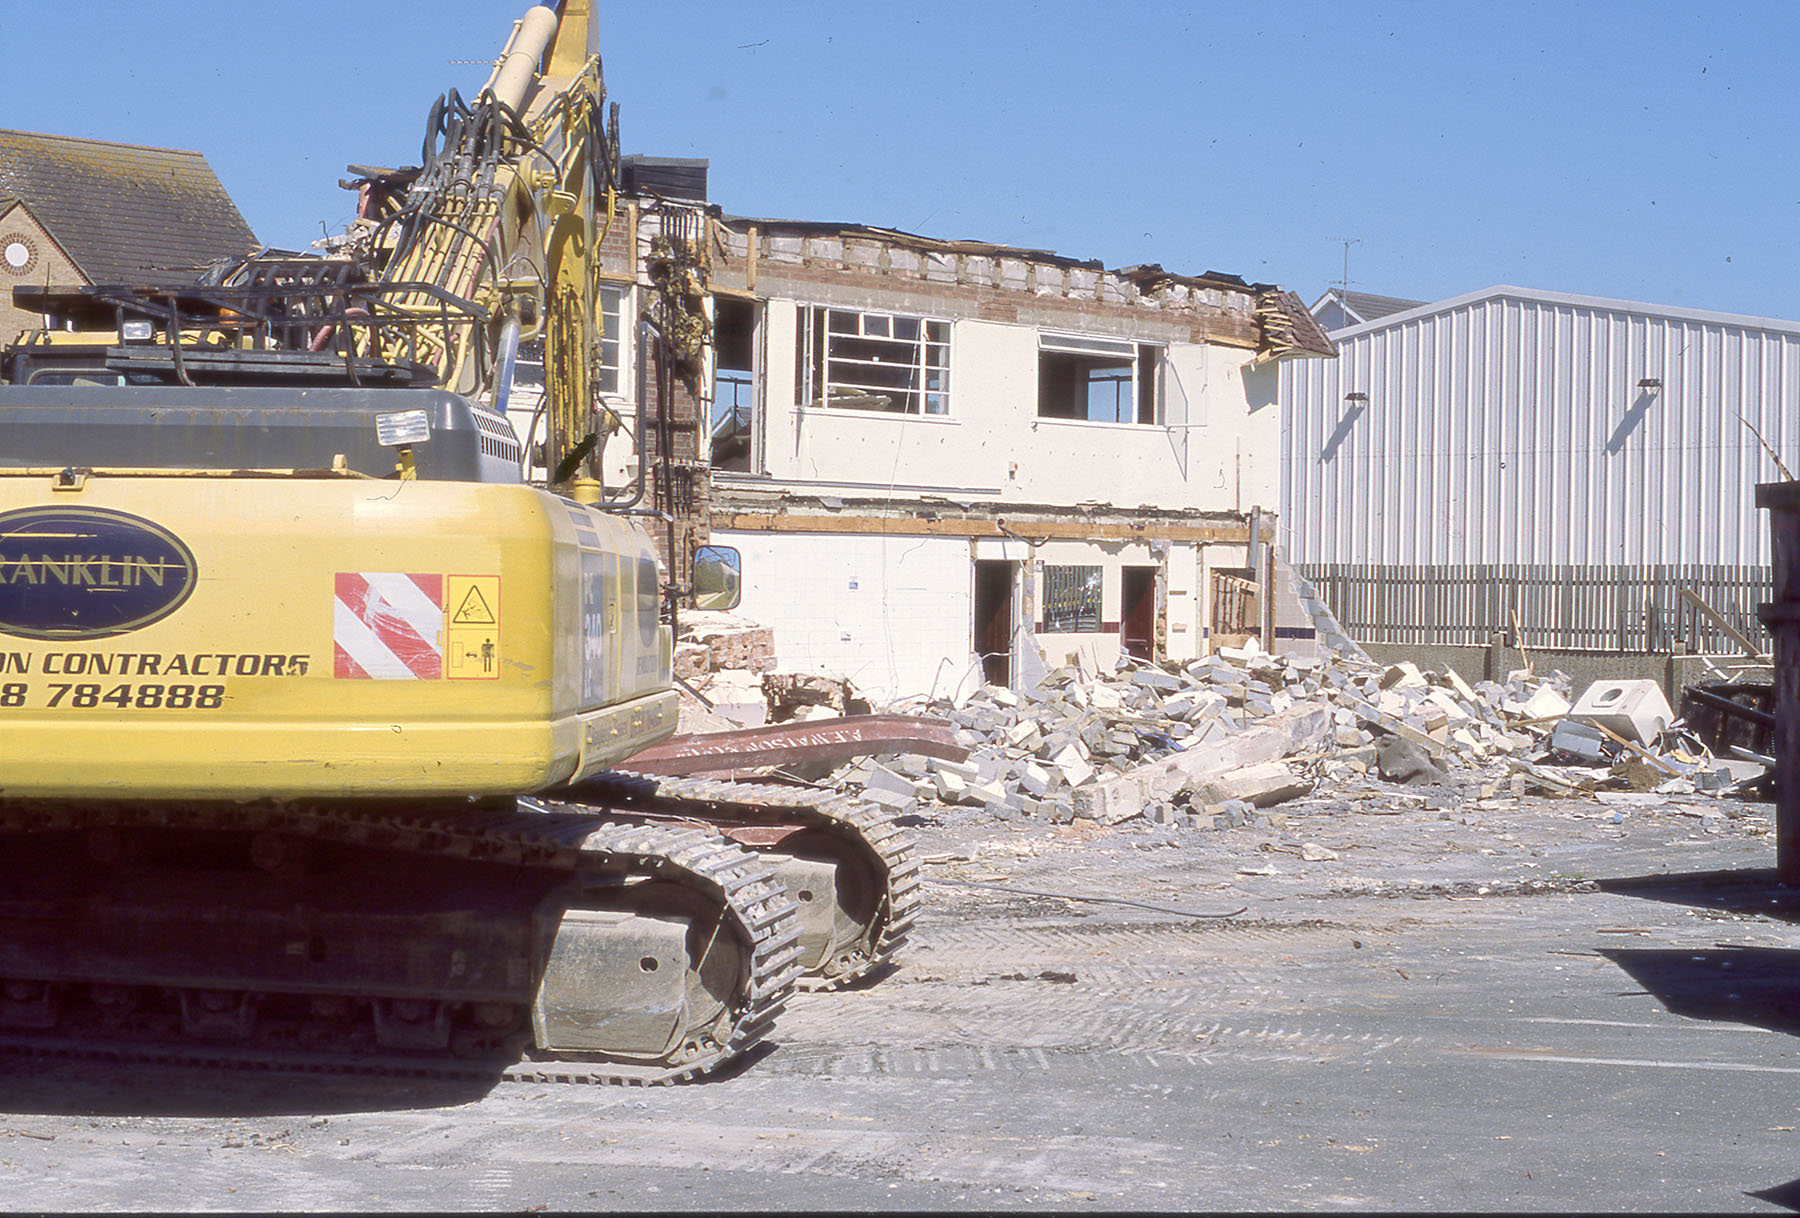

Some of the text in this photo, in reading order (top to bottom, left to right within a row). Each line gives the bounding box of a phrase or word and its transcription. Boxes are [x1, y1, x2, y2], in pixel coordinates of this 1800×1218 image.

[0, 652, 310, 677] N CONTRACTORS
[0, 683, 226, 708] 8 784888
